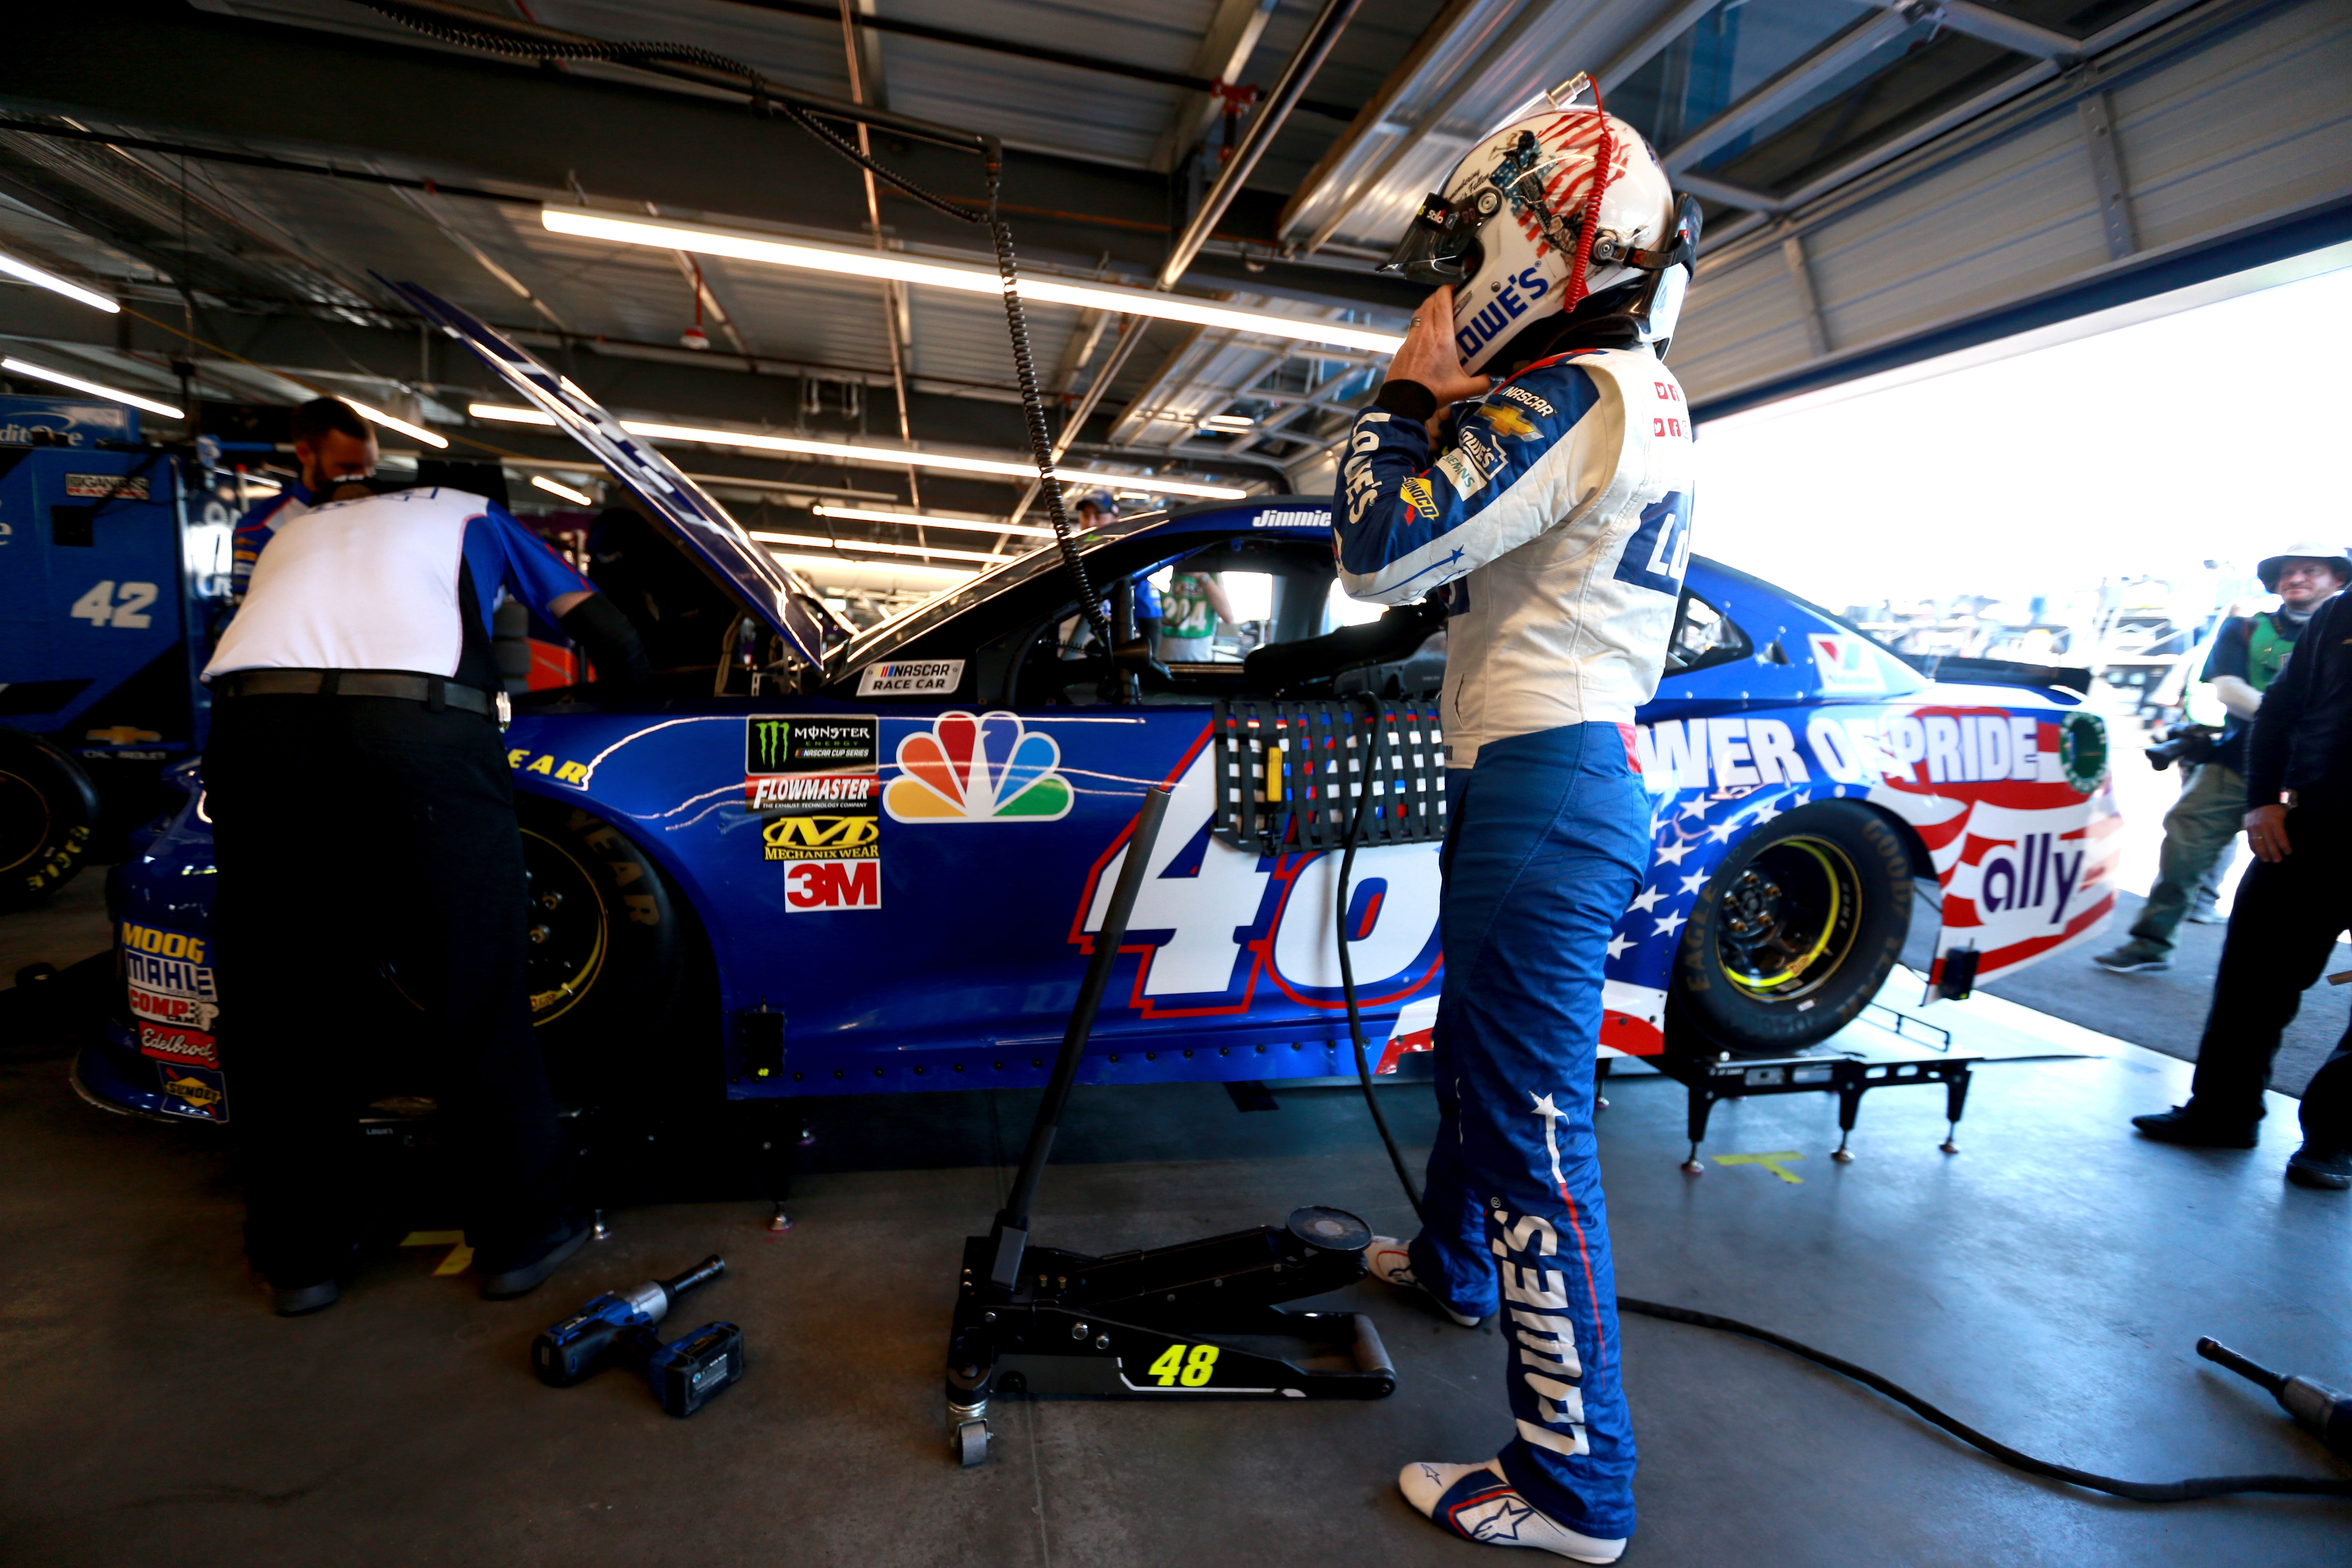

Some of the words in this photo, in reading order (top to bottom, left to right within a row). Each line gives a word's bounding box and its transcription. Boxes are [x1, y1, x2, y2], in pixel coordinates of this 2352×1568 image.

[1456, 267, 1548, 367] OWE'S
[1502, 386, 1554, 417] NASCAR
[1461, 430, 1496, 468] OWE'S
[1442, 454, 1475, 488] SIEMNS
[1403, 478, 1437, 516] SUNOCO
[1252, 510, 1332, 527] Jimmie
[70, 580, 158, 629] 42
[872, 680, 912, 690] RACE
[916, 679, 945, 689] CAR
[893, 664, 950, 677] NASCAR
[794, 725, 871, 740] MONSTER
[1887, 715, 2038, 783] PRIDE
[845, 749, 869, 757] SERIES
[753, 779, 870, 809] FLOWMASTER
[764, 846, 838, 860] MECHANIX
[838, 844, 879, 858] WEAR
[787, 862, 877, 908] 3M
[1982, 833, 2085, 925] ally
[122, 921, 206, 964] MOOG
[127, 951, 212, 996] MAHLE
[130, 989, 188, 1017] COMP
[167, 1083, 220, 1103] SUNOCO
[1491, 1208, 1590, 1456] LOWE'S
[1148, 1344, 1220, 1387] 48
